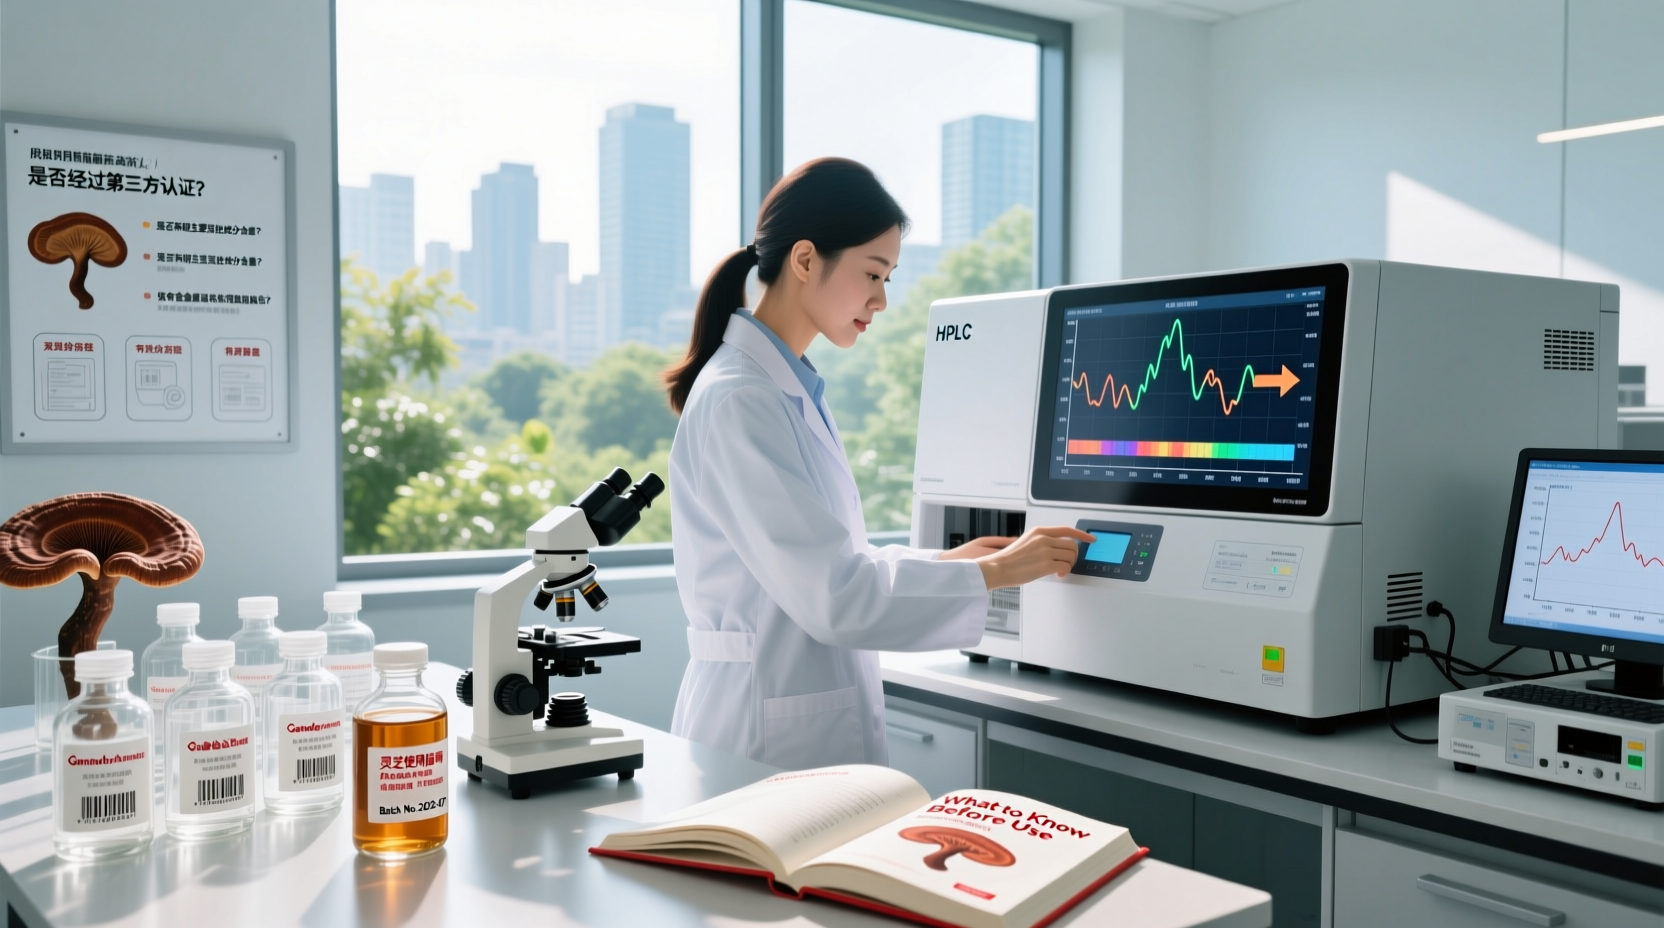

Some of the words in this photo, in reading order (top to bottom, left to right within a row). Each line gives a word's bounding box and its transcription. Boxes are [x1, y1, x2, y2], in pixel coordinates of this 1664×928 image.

[28, 166, 205, 197] 是否经过第三方认证?
[936, 323, 973, 342] HPLC
[926, 805, 1006, 825] Before
[1011, 820, 1053, 840] Use
[944, 796, 1001, 811] What
[1001, 805, 1023, 817] to
[1027, 812, 1091, 839] Know
